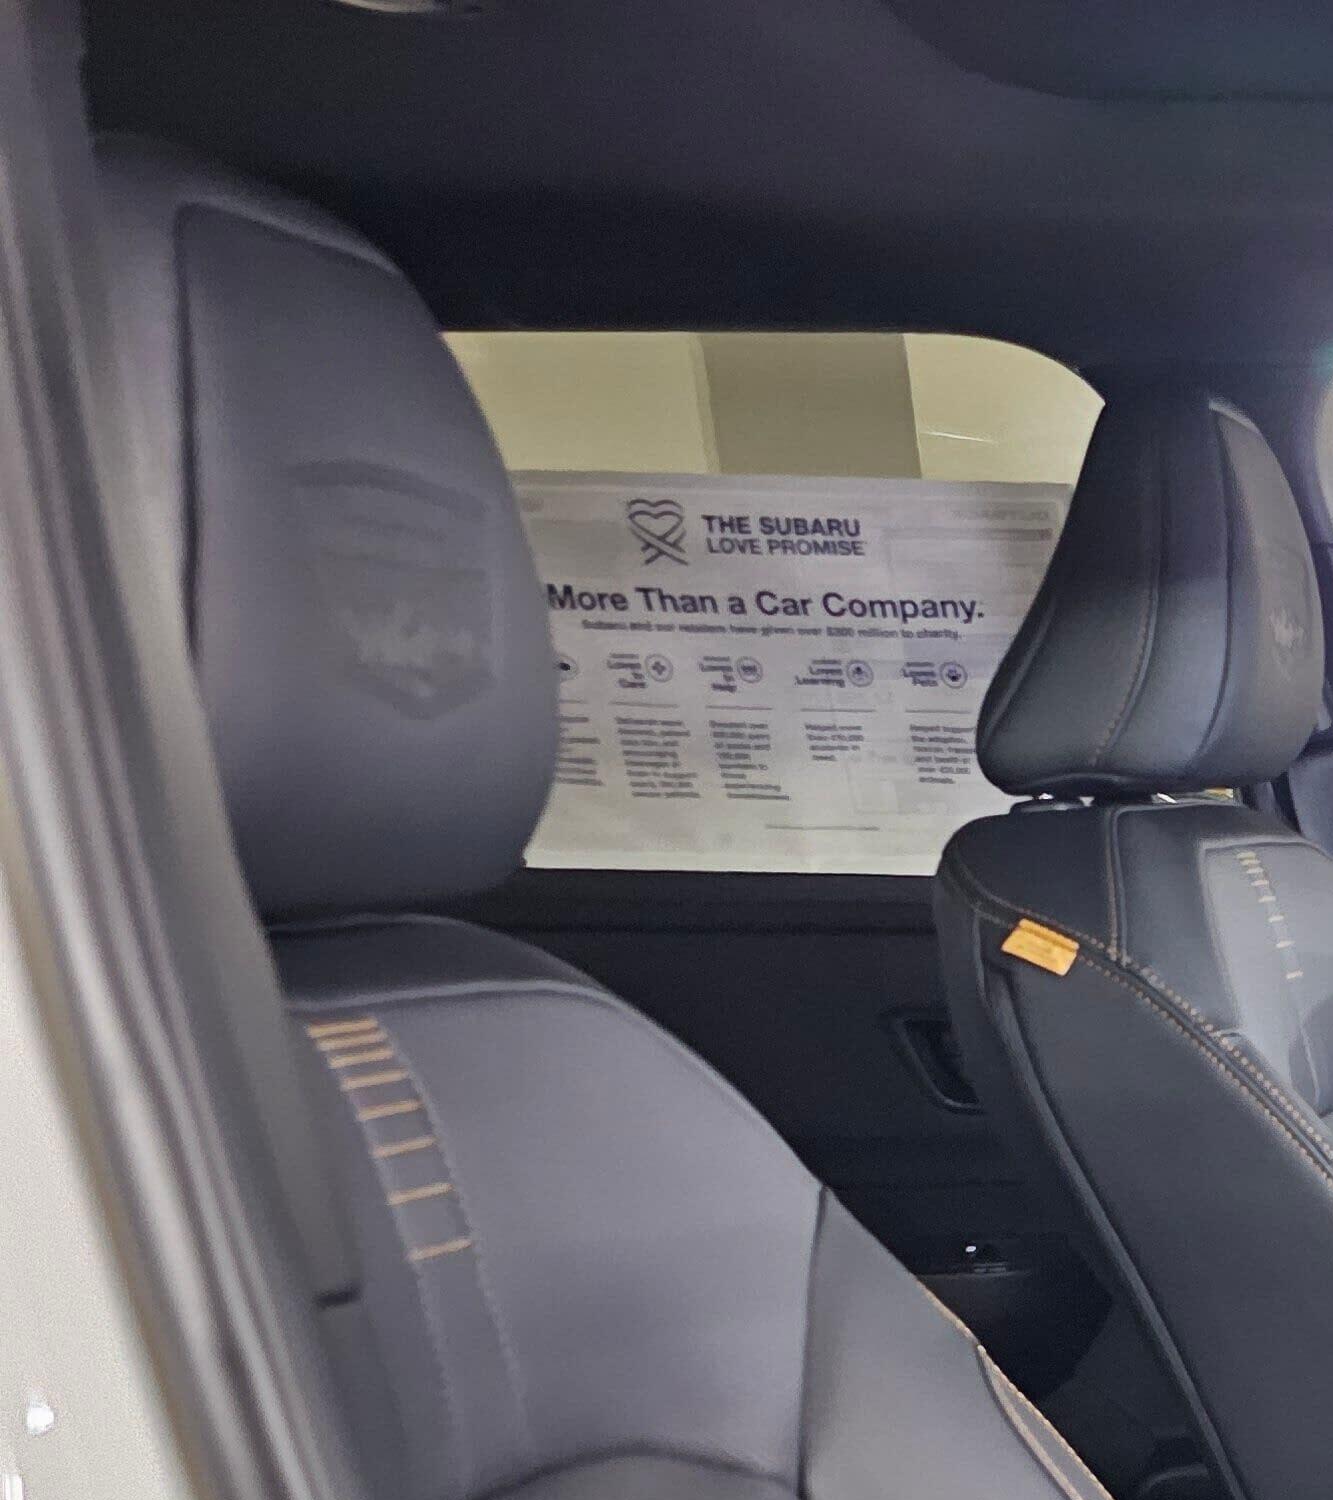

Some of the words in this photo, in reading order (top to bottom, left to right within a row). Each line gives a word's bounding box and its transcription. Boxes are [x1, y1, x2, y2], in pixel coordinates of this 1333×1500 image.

[701, 515, 751, 535] THE
[759, 516, 861, 537] SUBARU
[705, 538, 762, 554] LOVE
[767, 539, 866, 556] PROMISE
[547, 583, 629, 611] More
[635, 586, 719, 614] Than
[729, 595, 747, 615] a
[755, 590, 813, 616] Car
[821, 591, 985, 624] Company.
